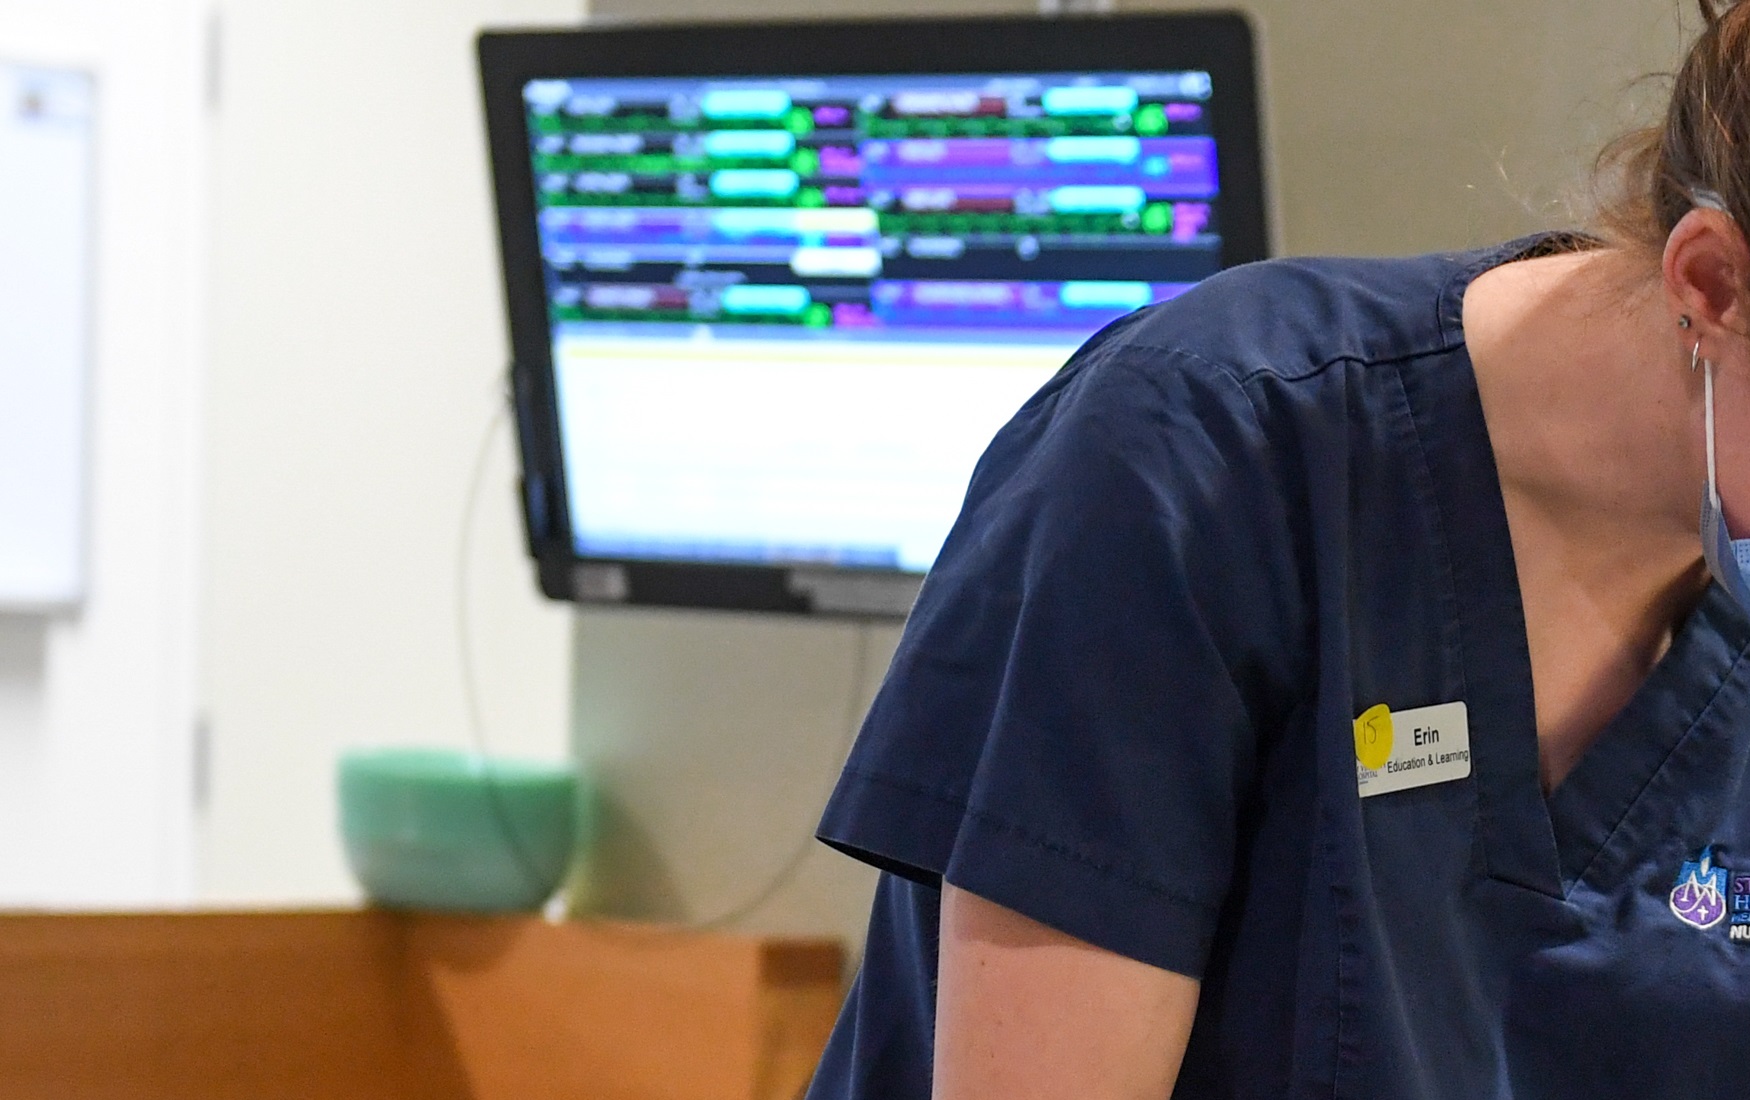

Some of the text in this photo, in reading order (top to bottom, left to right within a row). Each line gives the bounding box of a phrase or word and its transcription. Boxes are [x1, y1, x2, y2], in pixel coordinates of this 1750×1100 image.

[1363, 716, 1379, 745] 15
[1414, 726, 1440, 746] Erin
[1387, 757, 1426, 774] Education
[1428, 753, 1434, 767] &
[1436, 749, 1469, 765] Learning
